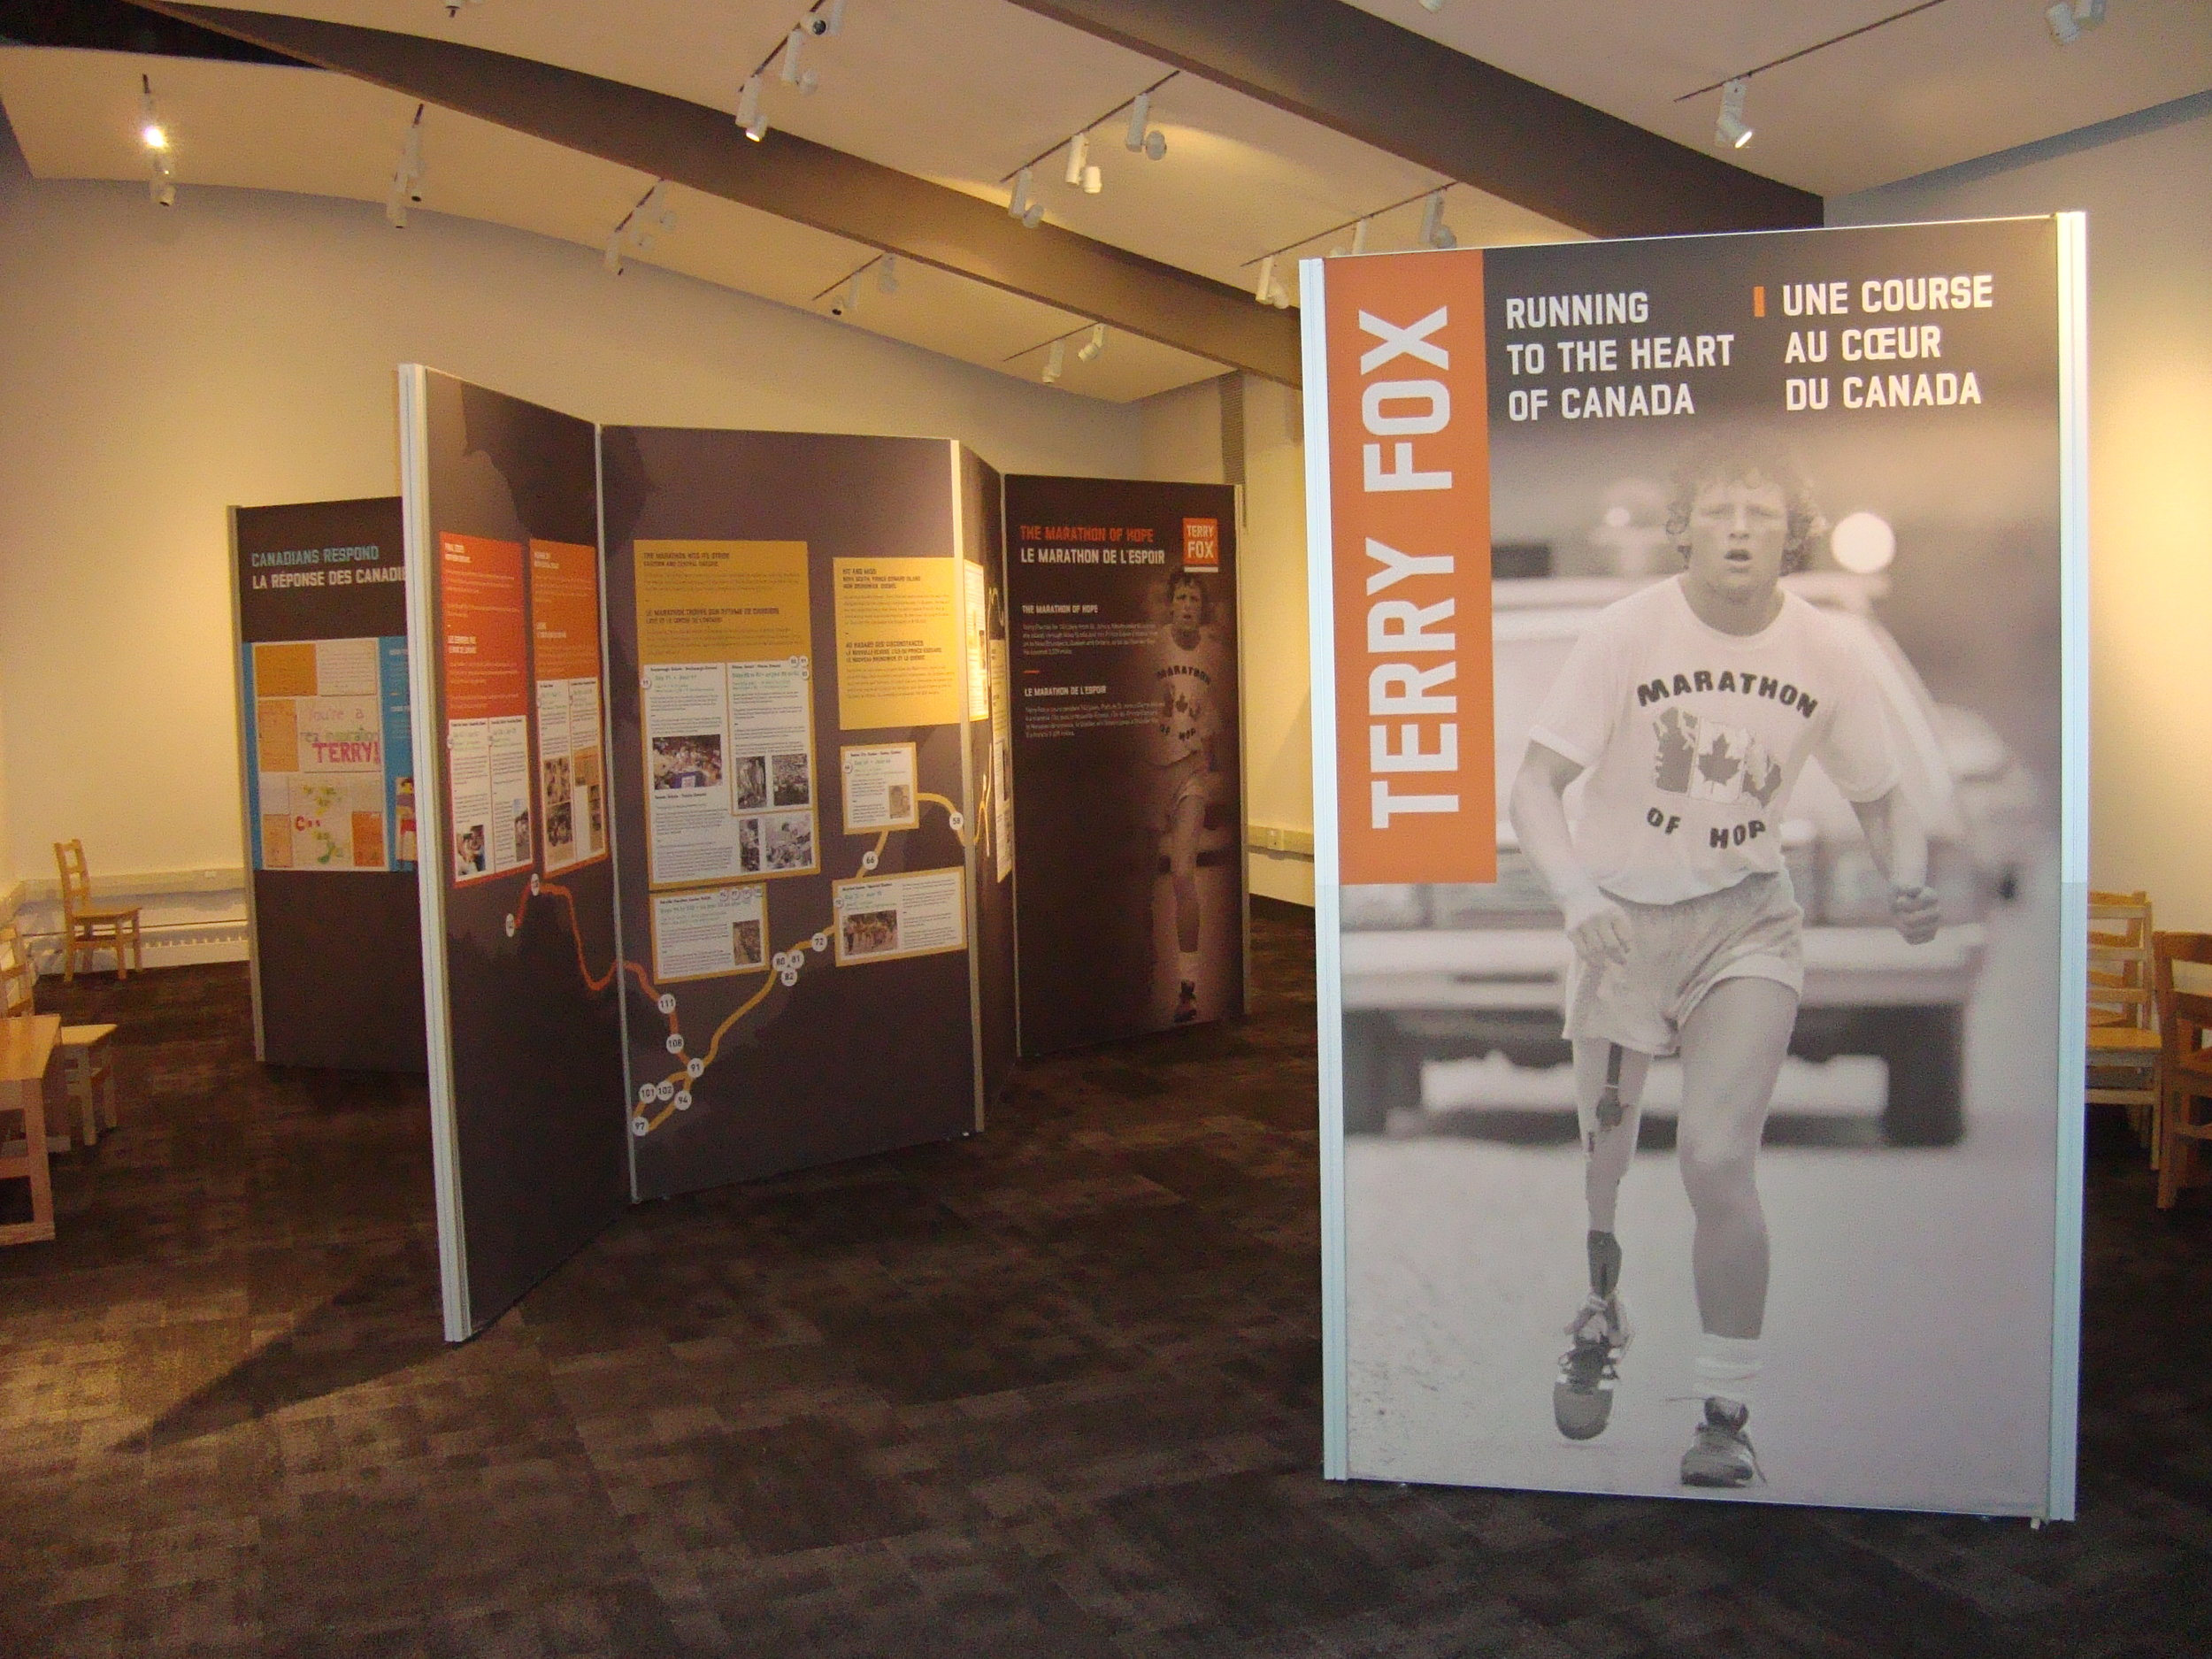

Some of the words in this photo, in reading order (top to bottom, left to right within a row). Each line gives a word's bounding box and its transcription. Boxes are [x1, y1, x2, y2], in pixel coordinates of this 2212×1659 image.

[1506, 292, 1648, 330] RUNNING
[1783, 282, 1848, 316] UNE
[1862, 275, 1993, 313] COURSE
[1506, 343, 1545, 375] TO
[1557, 340, 1617, 373] THE
[1631, 334, 1735, 370] HEART
[1785, 330, 1827, 364] AU
[1841, 326, 1941, 361] CŒUR
[1358, 305, 1453, 492] FOX
[1509, 389, 1548, 421] OF
[1561, 383, 1695, 419] CANADA
[1786, 378, 1829, 411] DU
[1843, 372, 1981, 409] CANADA
[1020, 526, 1041, 541] THE
[1045, 526, 1105, 541] MARATHON
[1110, 528, 1123, 541] OF
[1127, 528, 1154, 542] HOPE
[1187, 525, 1214, 538] TERRY
[251, 549, 319, 567] CANADIANS
[323, 546, 380, 563] RESPOND
[1021, 548, 1035, 563] LE
[1038, 549, 1099, 564] MARATHON
[1103, 549, 1118, 564] DE
[1120, 549, 1165, 564] L'ESPOIR
[1187, 541, 1214, 558] FOX
[252, 575, 267, 589] LA
[328, 570, 353, 585] DES
[1036, 605, 1070, 614] MARATHON
[1082, 605, 1098, 613] HOPE
[1034, 687, 1068, 696] MARATHON
[1070, 686, 1079, 695] DE
[1365, 537, 1459, 829] TERRY
[1637, 671, 1818, 718] MARATHON
[1647, 807, 1681, 834] OF
